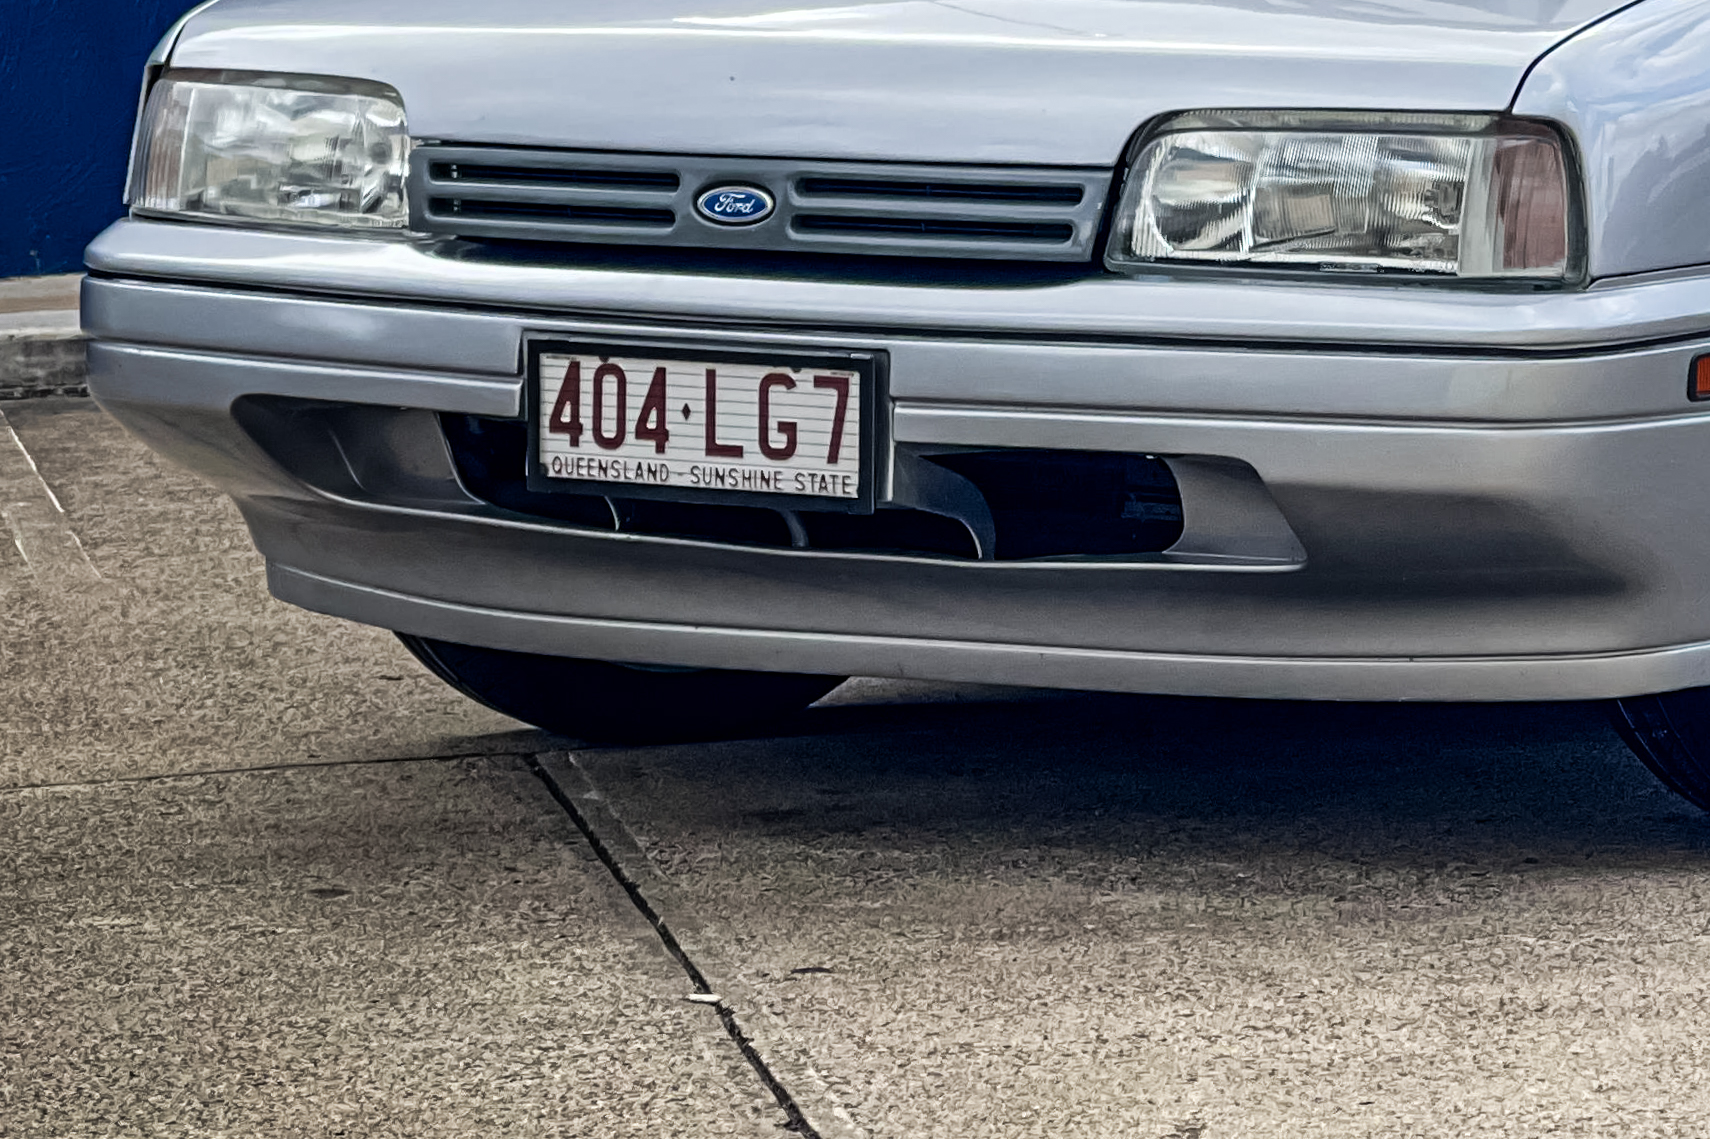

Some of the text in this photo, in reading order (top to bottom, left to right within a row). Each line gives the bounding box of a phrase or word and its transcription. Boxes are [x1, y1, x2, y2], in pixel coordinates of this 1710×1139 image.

[713, 192, 756, 214] Ford
[549, 361, 850, 464] 404 LG7
[552, 456, 854, 495] QUEENSLAND SUNSHINE STATE
